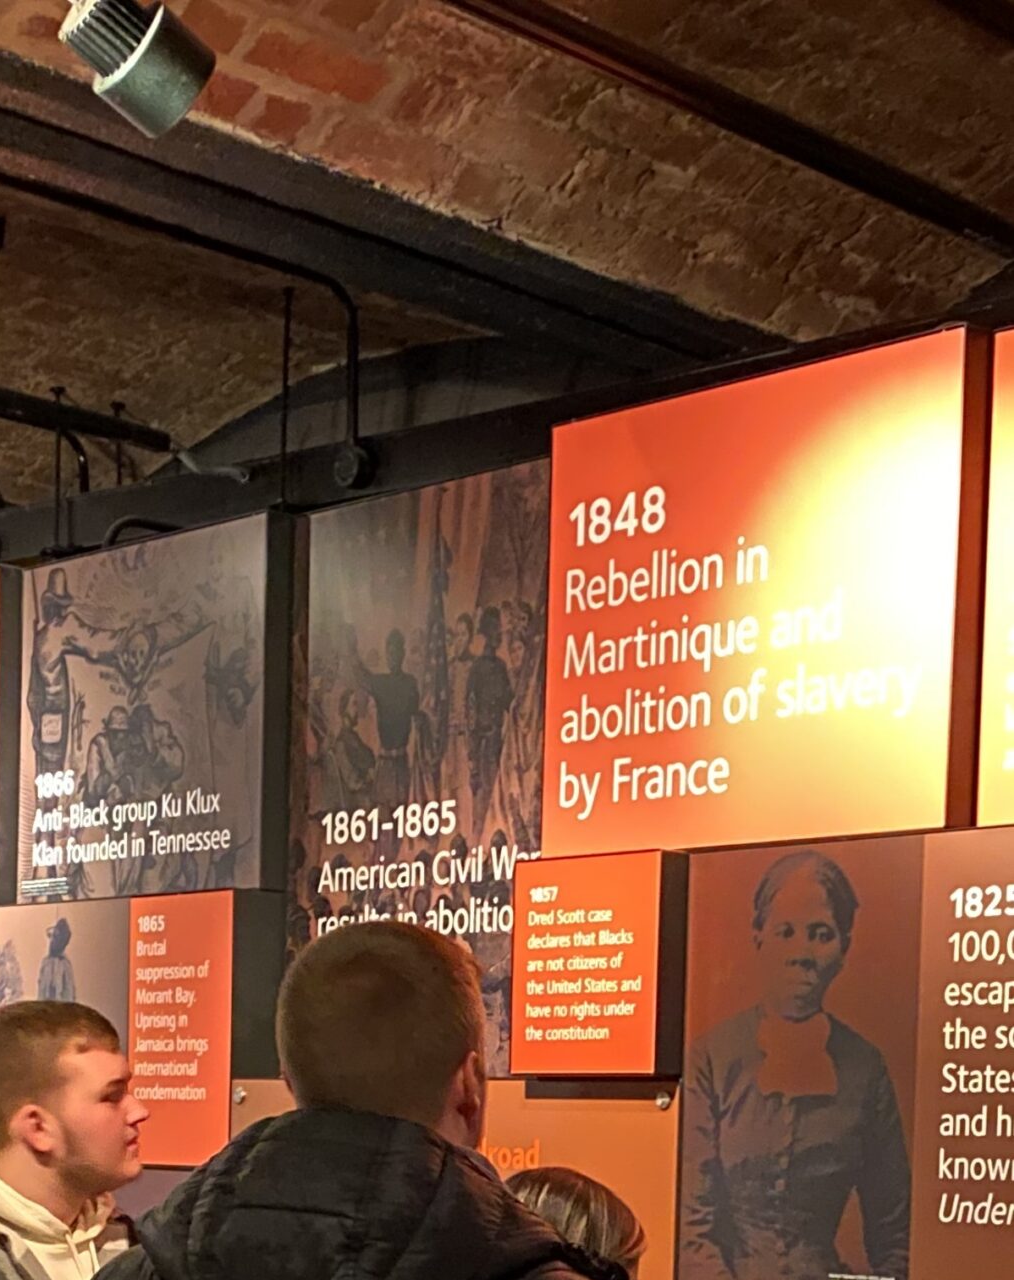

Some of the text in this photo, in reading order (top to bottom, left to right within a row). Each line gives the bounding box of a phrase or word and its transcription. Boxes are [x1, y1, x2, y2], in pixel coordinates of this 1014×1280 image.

[569, 485, 666, 547] 1848
[565, 535, 769, 615] Rebellion in
[563, 586, 843, 679] Martinique and
[560, 662, 922, 744] abolition of slavery
[35, 769, 75, 799] 1866
[558, 757, 730, 821] by France
[32, 787, 221, 834] Anti-Black group Ku Klux
[321, 800, 456, 845] 1861-1865
[32, 829, 231, 867] Klan founded in Tennessee
[317, 855, 425, 894] American
[432, 844, 483, 885] Civil
[137, 915, 165, 933] 1865
[527, 908, 613, 927] Dred Scott case
[136, 940, 167, 957] Brutal
[527, 928, 634, 950] declares that Blacks
[135, 959, 210, 984] suppression of
[526, 951, 624, 973] are not citizens of
[135, 987, 173, 1004] Morant
[526, 975, 643, 996] the United States and
[135, 1011, 188, 1033] Uprising in
[525, 1000, 636, 1021] have no rights under
[134, 1034, 209, 1057] Jamaica brings
[525, 1025, 610, 1041] the constitution
[942, 1017, 987, 1050] the
[134, 1058, 198, 1076] international
[941, 1062, 1014, 1094] State
[134, 1081, 207, 1101] condemnation
[939, 1104, 1014, 1137] and h
[938, 1147, 1014, 1181] know
